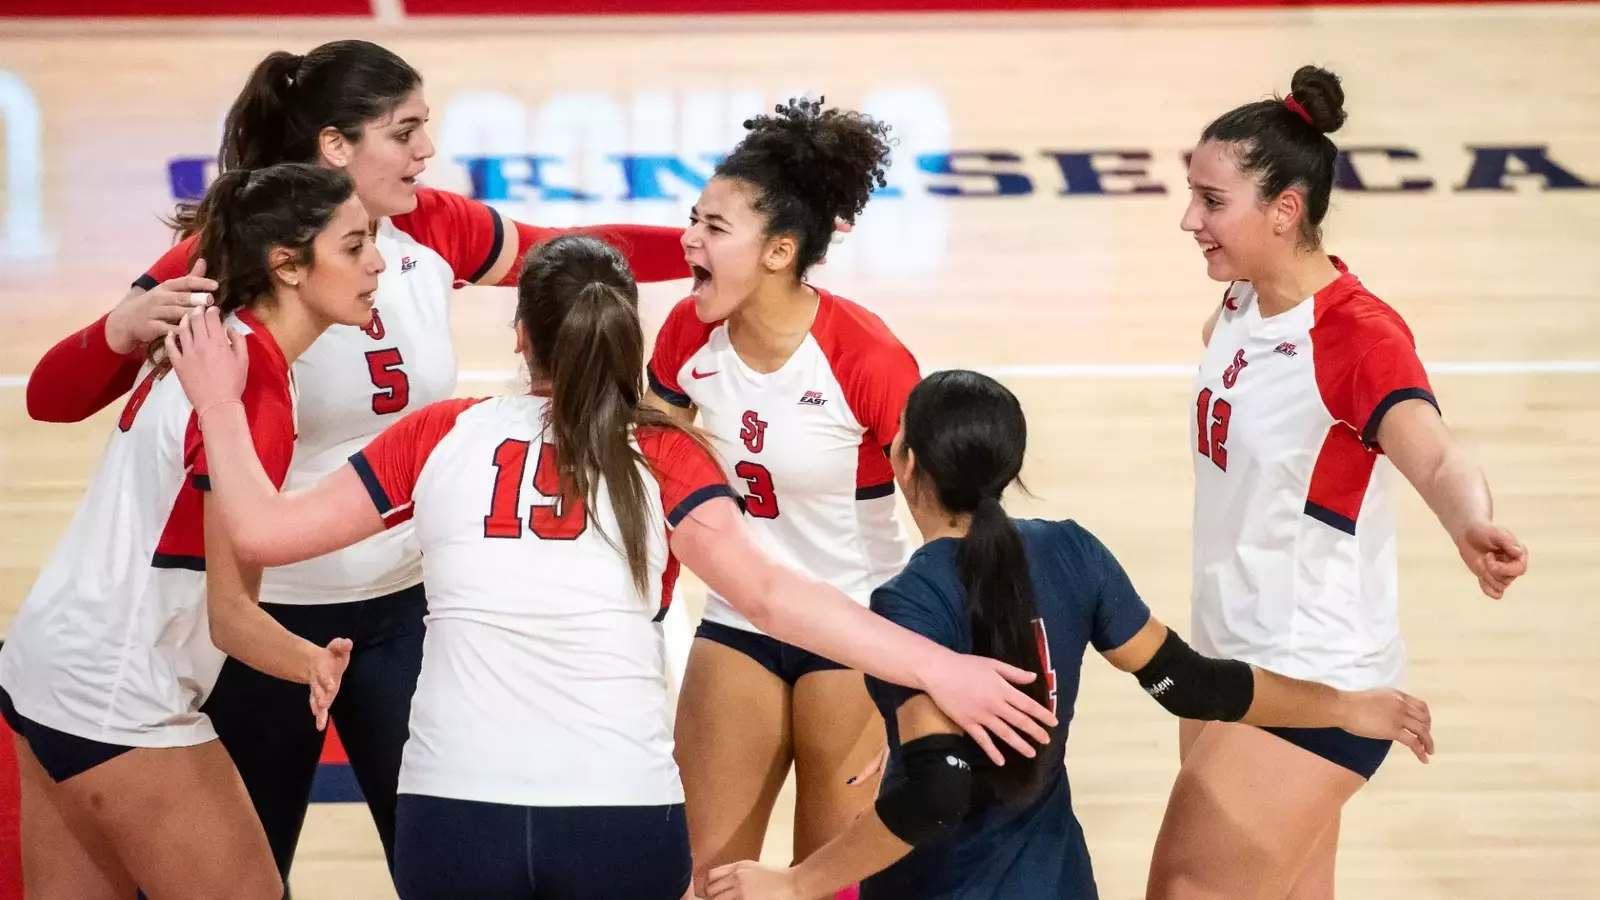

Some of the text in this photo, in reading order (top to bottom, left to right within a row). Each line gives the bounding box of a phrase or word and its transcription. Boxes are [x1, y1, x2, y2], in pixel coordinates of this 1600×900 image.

[364, 347, 411, 415] 5
[799, 396, 828, 406] EAST
[804, 390, 823, 398] BIG
[740, 410, 768, 453] SJ
[1196, 387, 1232, 473] 12
[735, 460, 780, 519] 3
